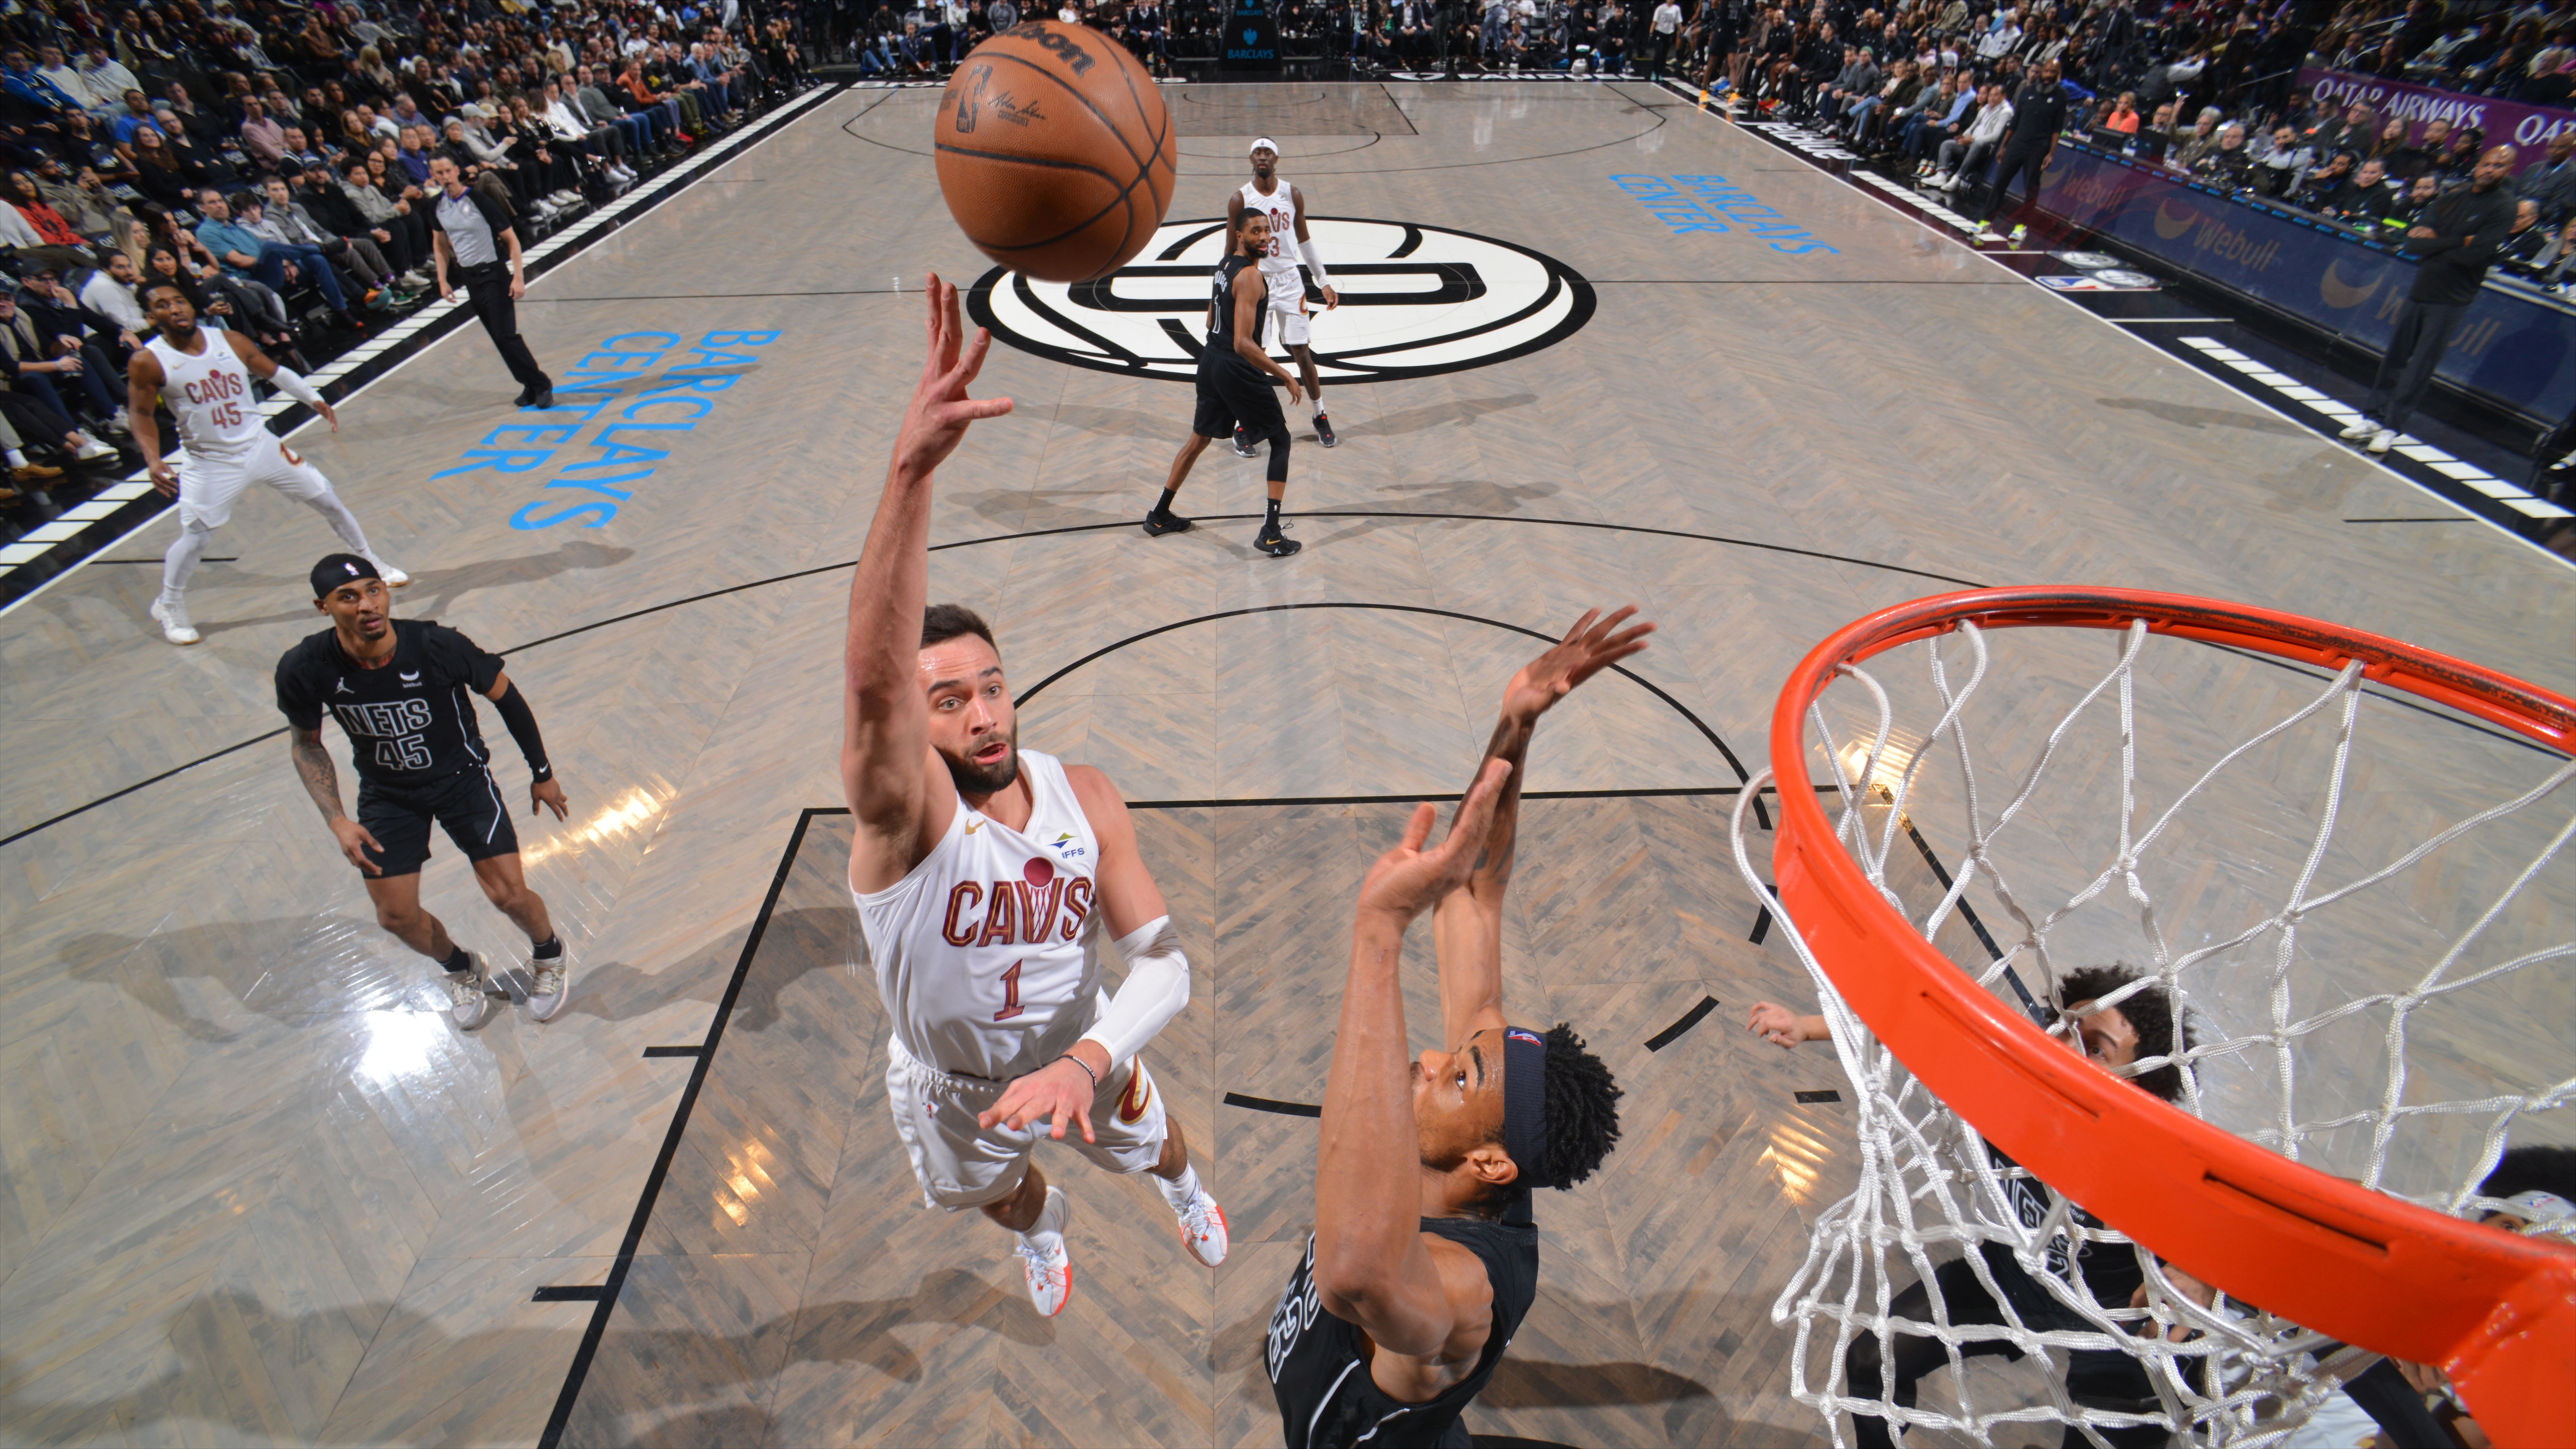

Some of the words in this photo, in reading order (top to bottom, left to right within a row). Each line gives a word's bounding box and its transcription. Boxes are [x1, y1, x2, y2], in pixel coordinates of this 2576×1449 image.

[1228, 49, 1274, 59] BARCLAYS
[2380, 91, 2488, 130] AIRWAYS
[1608, 174, 1730, 234] CENTER
[2064, 169, 2127, 211] Webull
[1267, 212, 1290, 232] VS
[1671, 175, 1840, 254] BARCLAYS
[2194, 215, 2281, 272] Webull
[1212, 295, 1221, 334] 1
[184, 372, 243, 405] CAVS
[428, 331, 681, 482] CENTER
[211, 402, 242, 429] 45
[509, 330, 783, 531] BARCLAYS
[335, 698, 432, 738] NETS
[376, 734, 432, 771] 45
[1062, 847, 1085, 859] IFFS
[942, 876, 1093, 947] CAVS
[994, 958, 1025, 1022] 1
[1073, 1056, 1092, 1071] FORWARD
[2068, 1206, 2086, 1221] ebull
